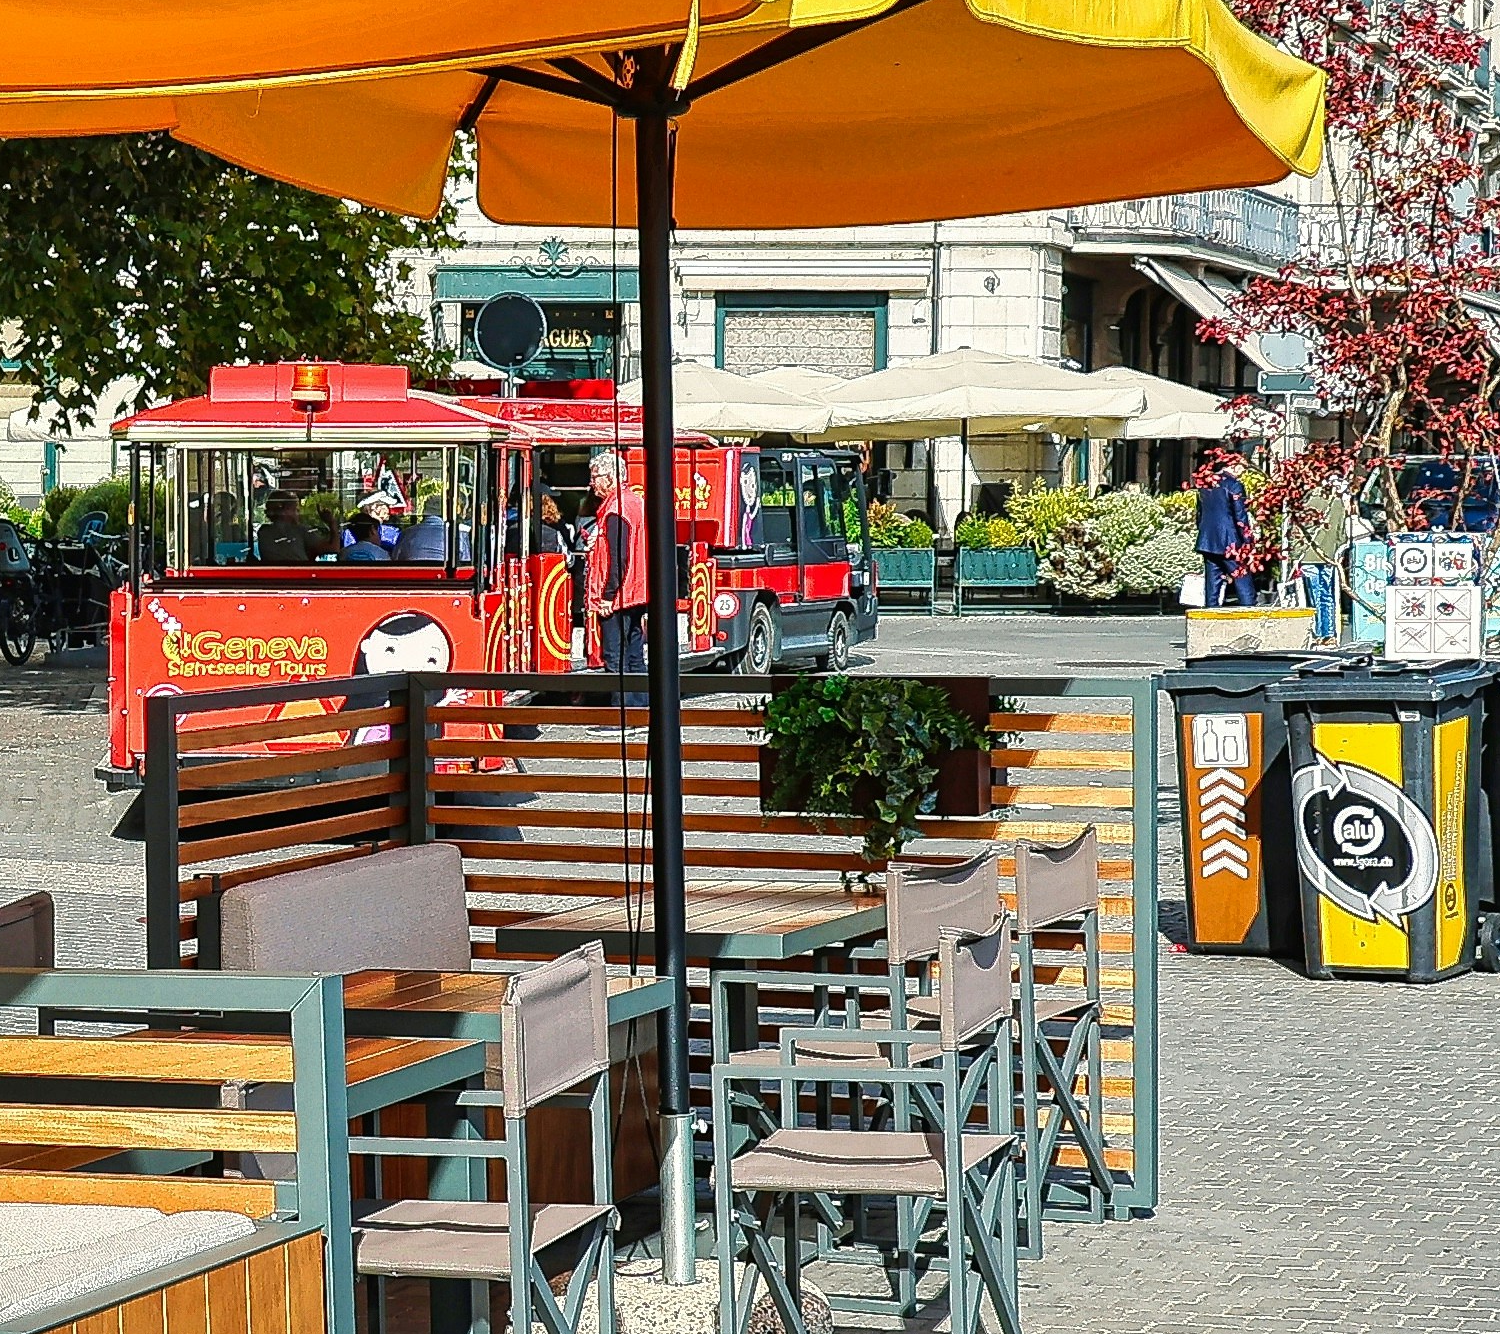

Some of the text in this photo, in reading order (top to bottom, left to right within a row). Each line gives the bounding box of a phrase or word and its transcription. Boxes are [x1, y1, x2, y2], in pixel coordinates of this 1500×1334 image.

[719, 599, 731, 611] 25
[192, 631, 329, 661] Geneva
[168, 660, 327, 677] Sightseeing Tours
[1343, 820, 1374, 841] alu
